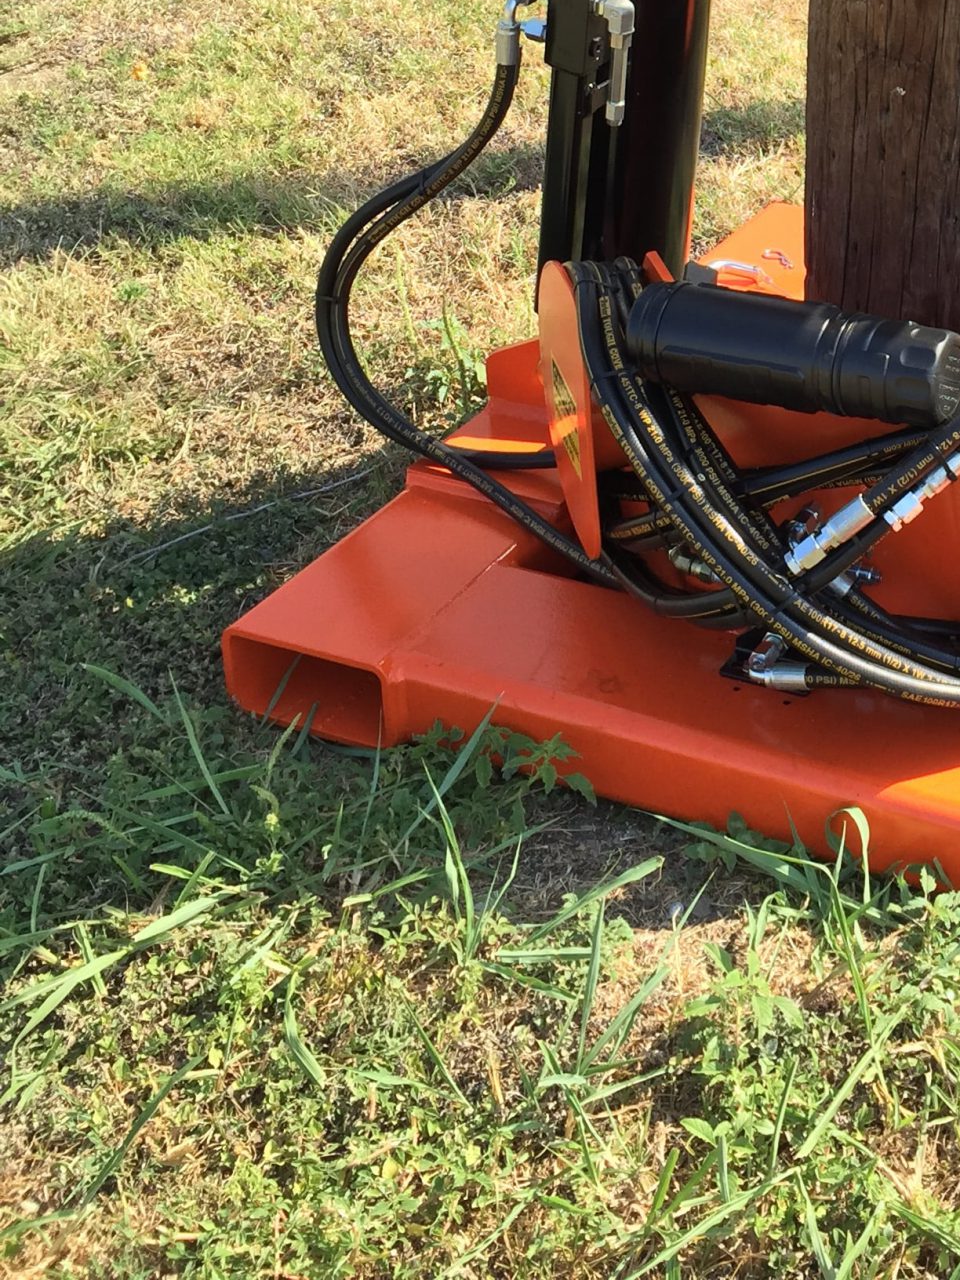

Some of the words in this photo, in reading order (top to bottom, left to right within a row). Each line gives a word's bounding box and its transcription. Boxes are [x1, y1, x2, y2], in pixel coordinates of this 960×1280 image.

[620, 375, 641, 411] 451TC-8
[638, 408, 653, 425] WP
[645, 421, 664, 445] 21.0
[659, 440, 674, 463] MPa
[915, 453, 935, 470] mm
[671, 396, 683, 411] WP
[684, 425, 697, 444] MPa
[705, 466, 721, 486] PSI)
[716, 485, 741, 516] MSHA
[738, 513, 770, 551] IC-40/26
[896, 468, 918, 488] (1/2)
[688, 484, 706, 506] PSI)
[887, 483, 899, 496] X
[872, 494, 889, 509] 1W
[703, 504, 727, 533] MSHA
[723, 527, 760, 567] IC-40/26
[620, 436, 647, 478] TOUGH
[671, 513, 702, 553] 451TC-8
[700, 548, 716, 566] WP
[714, 564, 734, 584] 21.0
[730, 581, 751, 603] MPa
[773, 622, 793, 640] PSI)
[791, 637, 821, 660] MSHA
[820, 656, 862, 681] IC-40/26
[899, 689, 923, 703] SAE
[793, 597, 808, 614] AE
[849, 594, 870, 615] SHA
[807, 606, 847, 640] 100R17-8
[846, 633, 866, 651] 12.5
[864, 645, 883, 661] mm
[882, 652, 902, 671] (1/2)
[902, 664, 911, 675] X
[815, 676, 837, 686] PSI)
